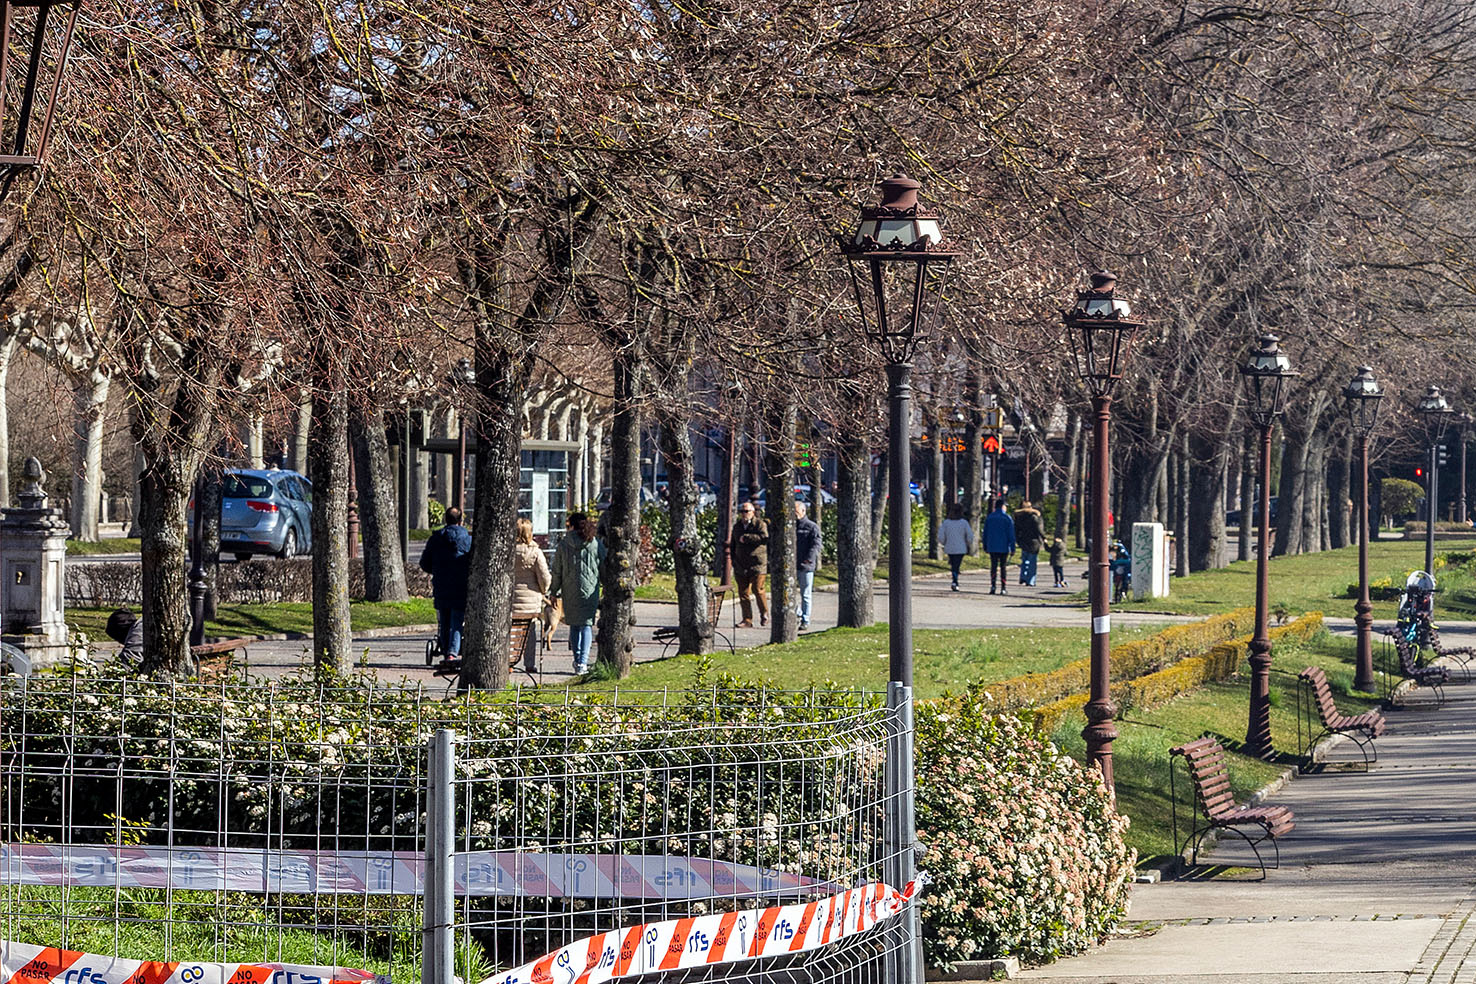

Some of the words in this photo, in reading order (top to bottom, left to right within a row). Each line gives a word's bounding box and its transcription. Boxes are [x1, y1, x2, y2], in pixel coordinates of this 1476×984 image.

[774, 919, 794, 941] rfs
[689, 931, 709, 953] rfs
[619, 950, 633, 961] ASAR
[31, 959, 48, 971] NO
[20, 967, 51, 981] PASAR
[236, 970, 253, 982] NO
